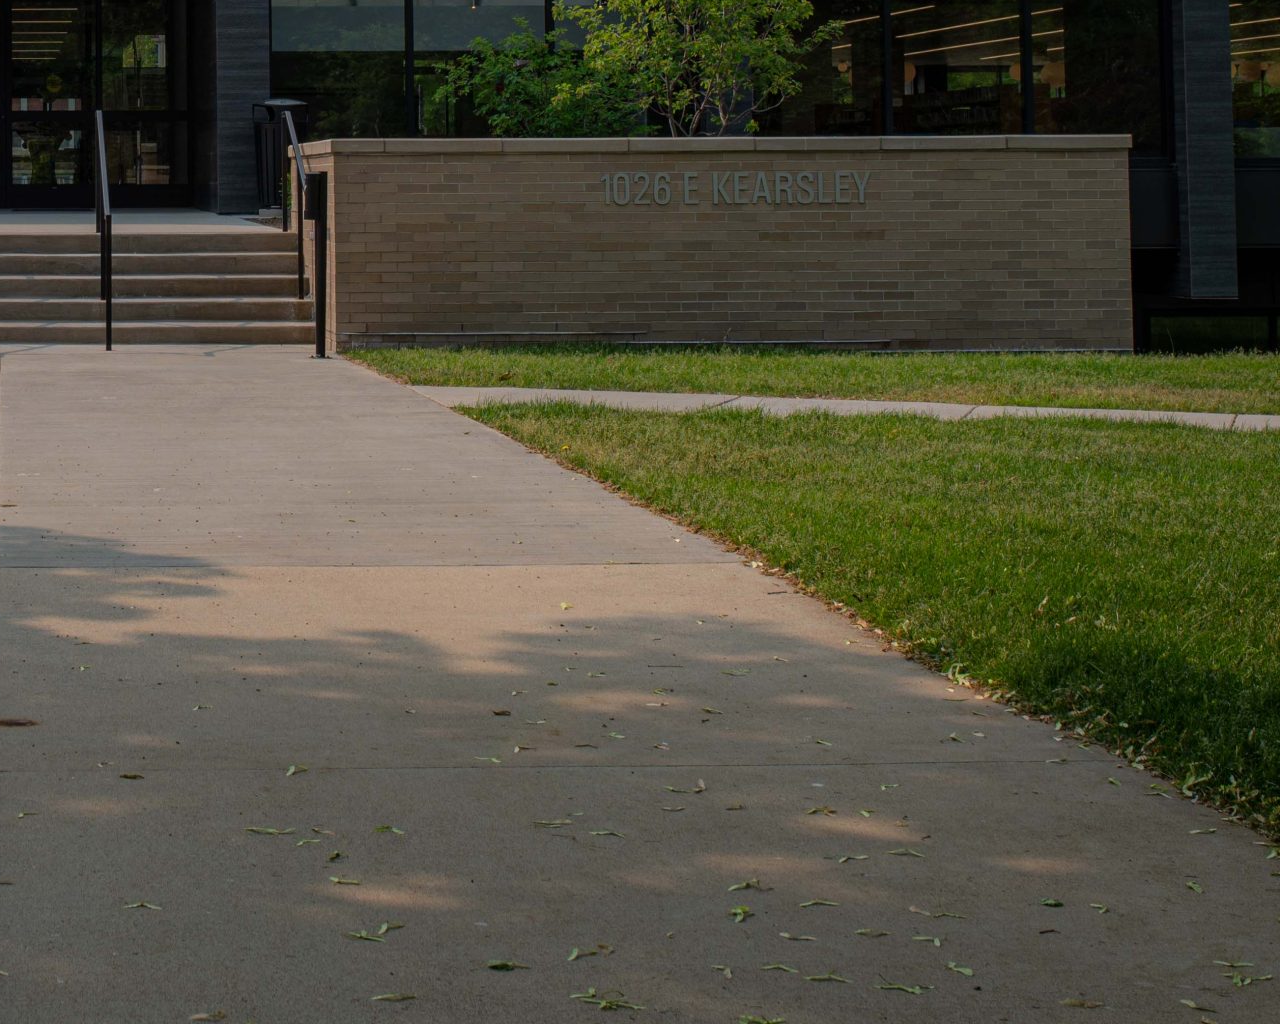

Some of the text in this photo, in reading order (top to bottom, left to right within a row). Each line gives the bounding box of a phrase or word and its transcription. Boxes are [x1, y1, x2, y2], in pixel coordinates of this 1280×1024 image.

[601, 171, 870, 205] 1026 E KEARSLEY
